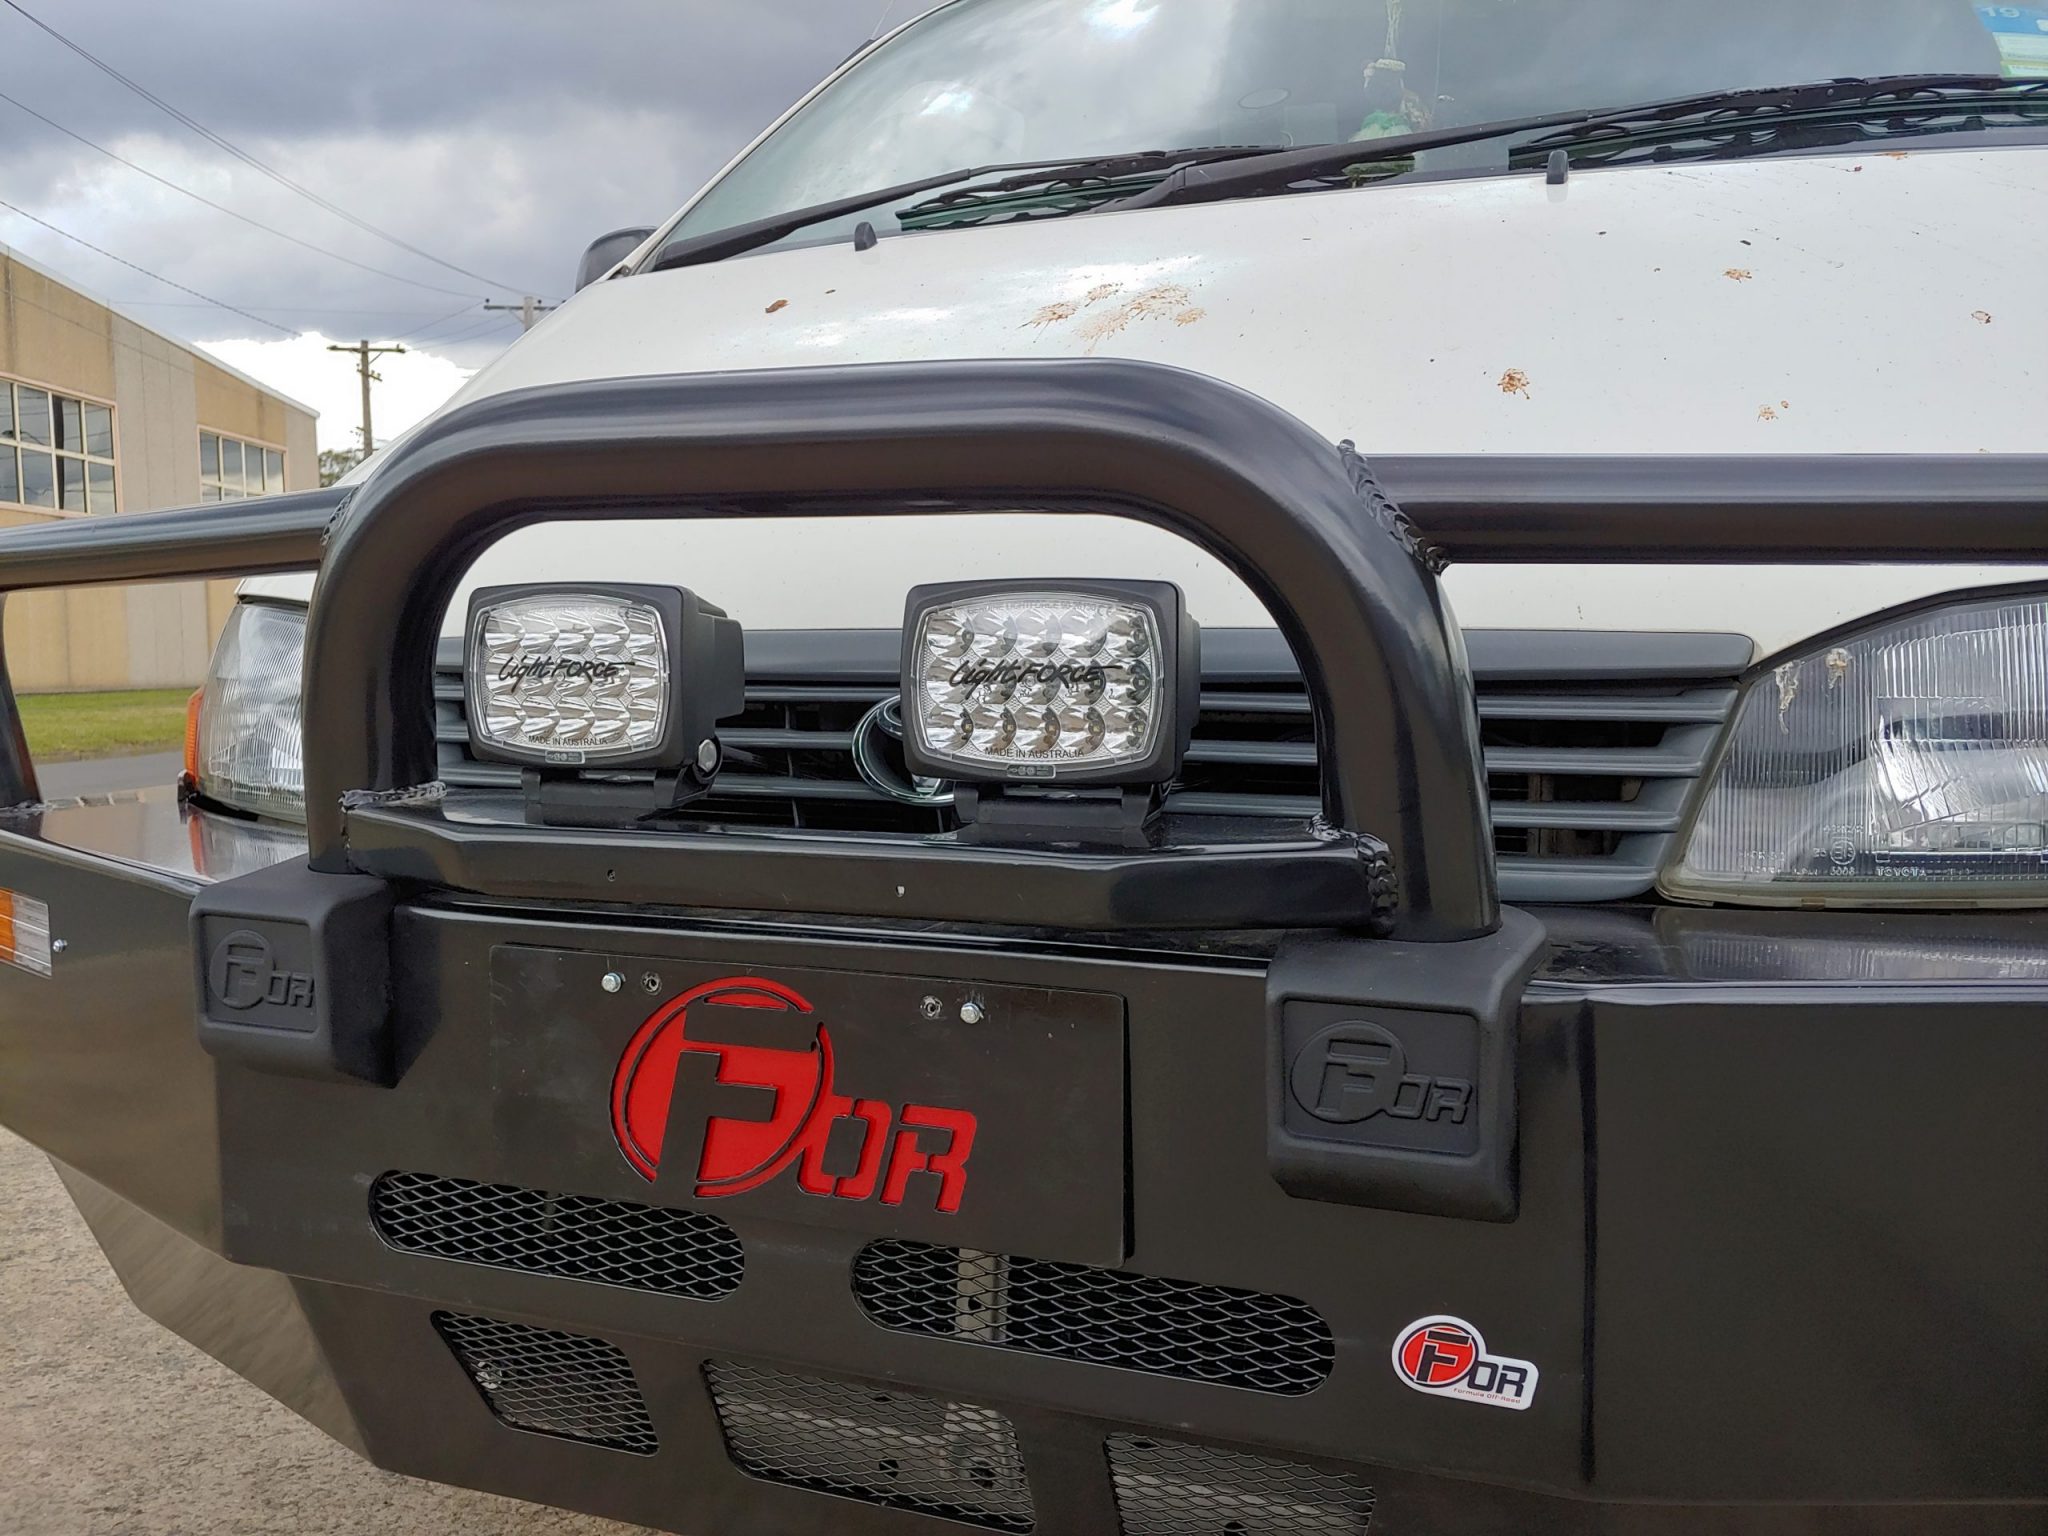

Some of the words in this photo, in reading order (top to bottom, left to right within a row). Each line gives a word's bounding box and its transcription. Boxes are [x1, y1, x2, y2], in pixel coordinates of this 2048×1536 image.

[528, 734, 550, 745] MADE
[551, 736, 560, 745] IN
[562, 737, 608, 746] AUSTRALIA
[985, 746, 1012, 758] MADE
[1014, 749, 1026, 759] IN
[1028, 749, 1085, 759] AUSTRALIA
[1876, 866, 1927, 876] TOYOTA
